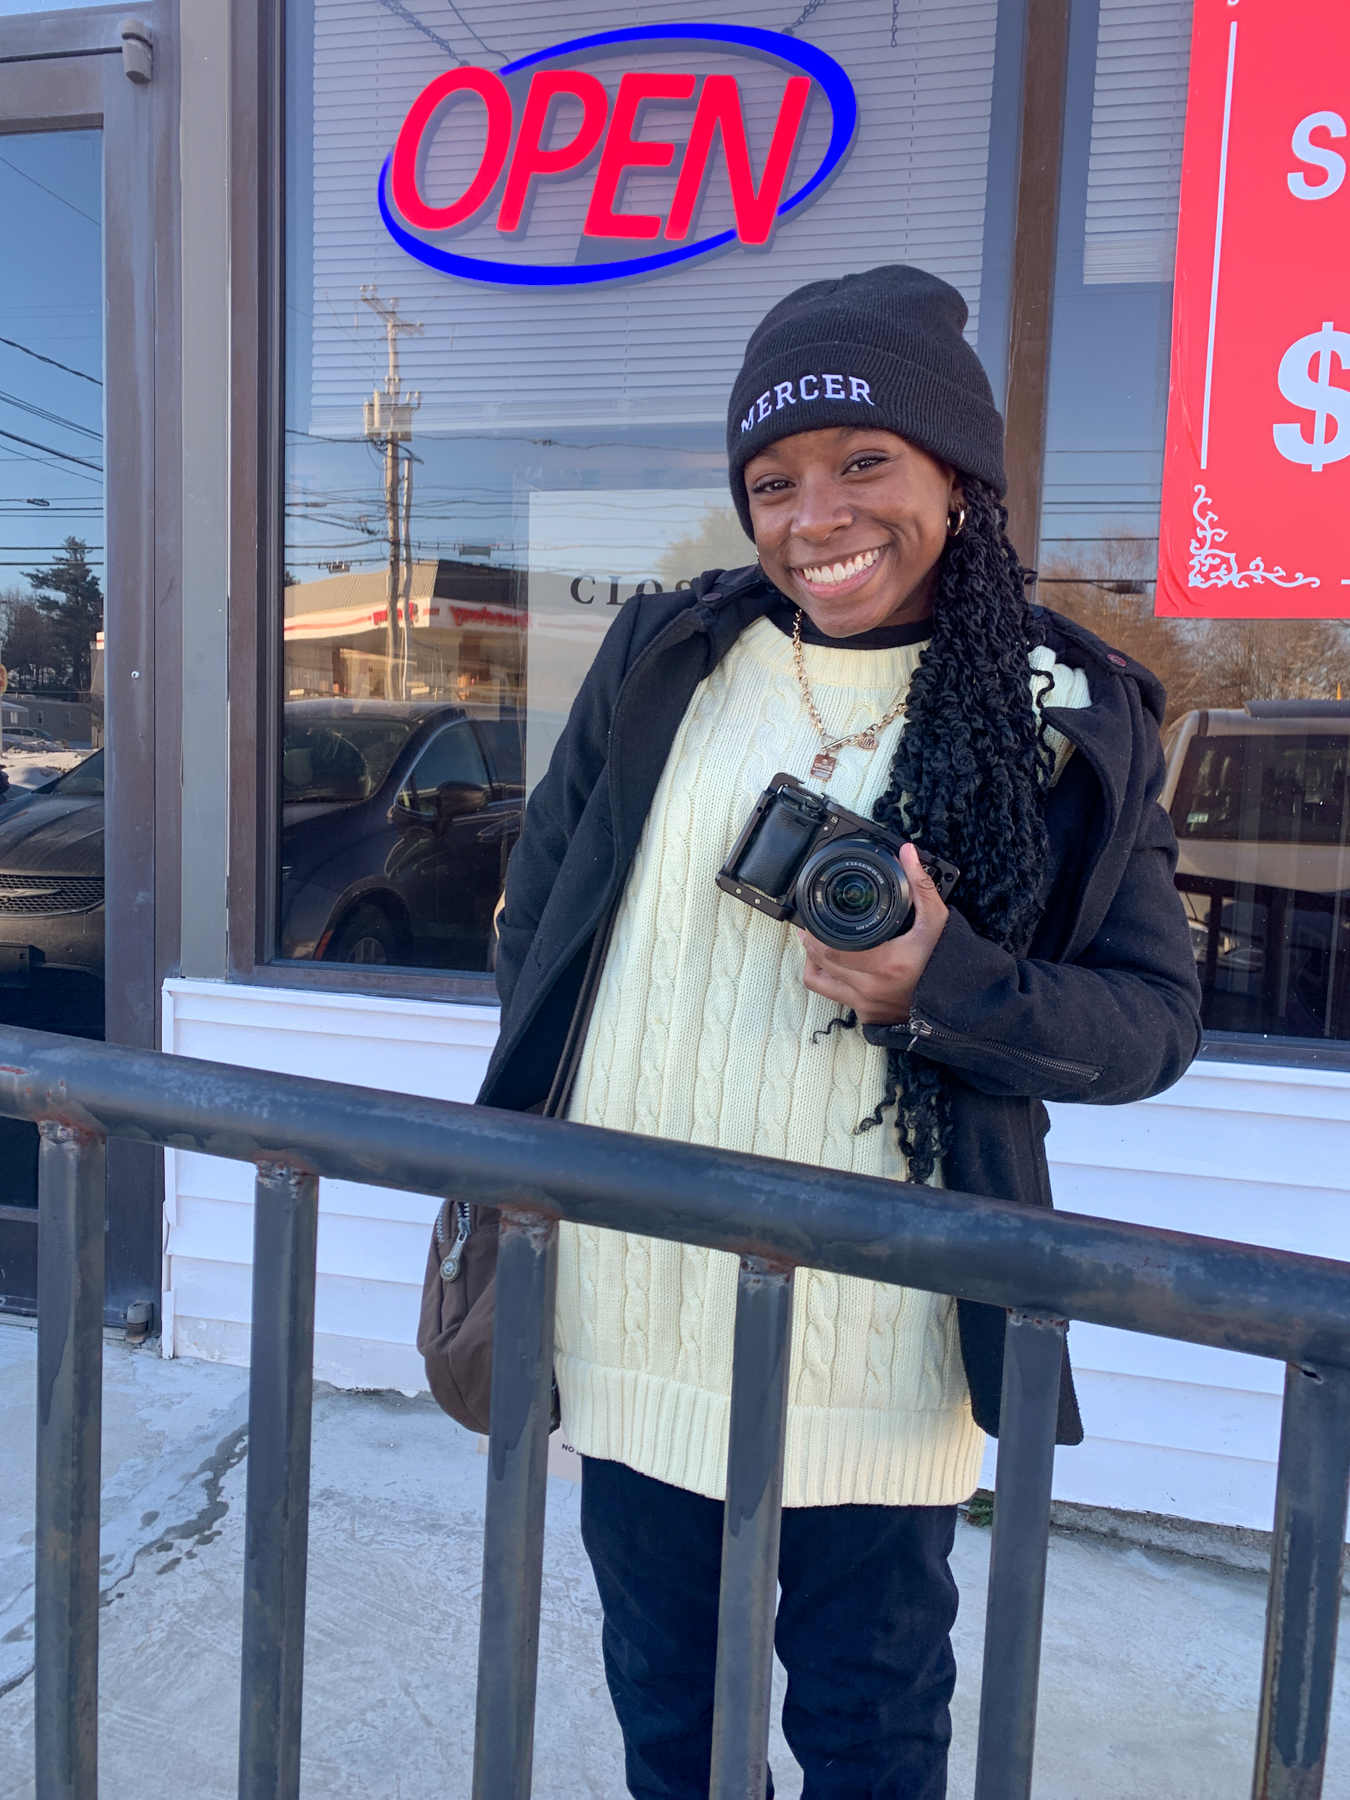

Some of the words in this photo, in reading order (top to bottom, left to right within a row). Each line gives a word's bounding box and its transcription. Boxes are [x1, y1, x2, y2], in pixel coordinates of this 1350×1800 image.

[392, 66, 812, 244] OPEN
[1287, 111, 1347, 200] S
[741, 374, 875, 433] MERCER
[561, 1443, 575, 1453] NO
